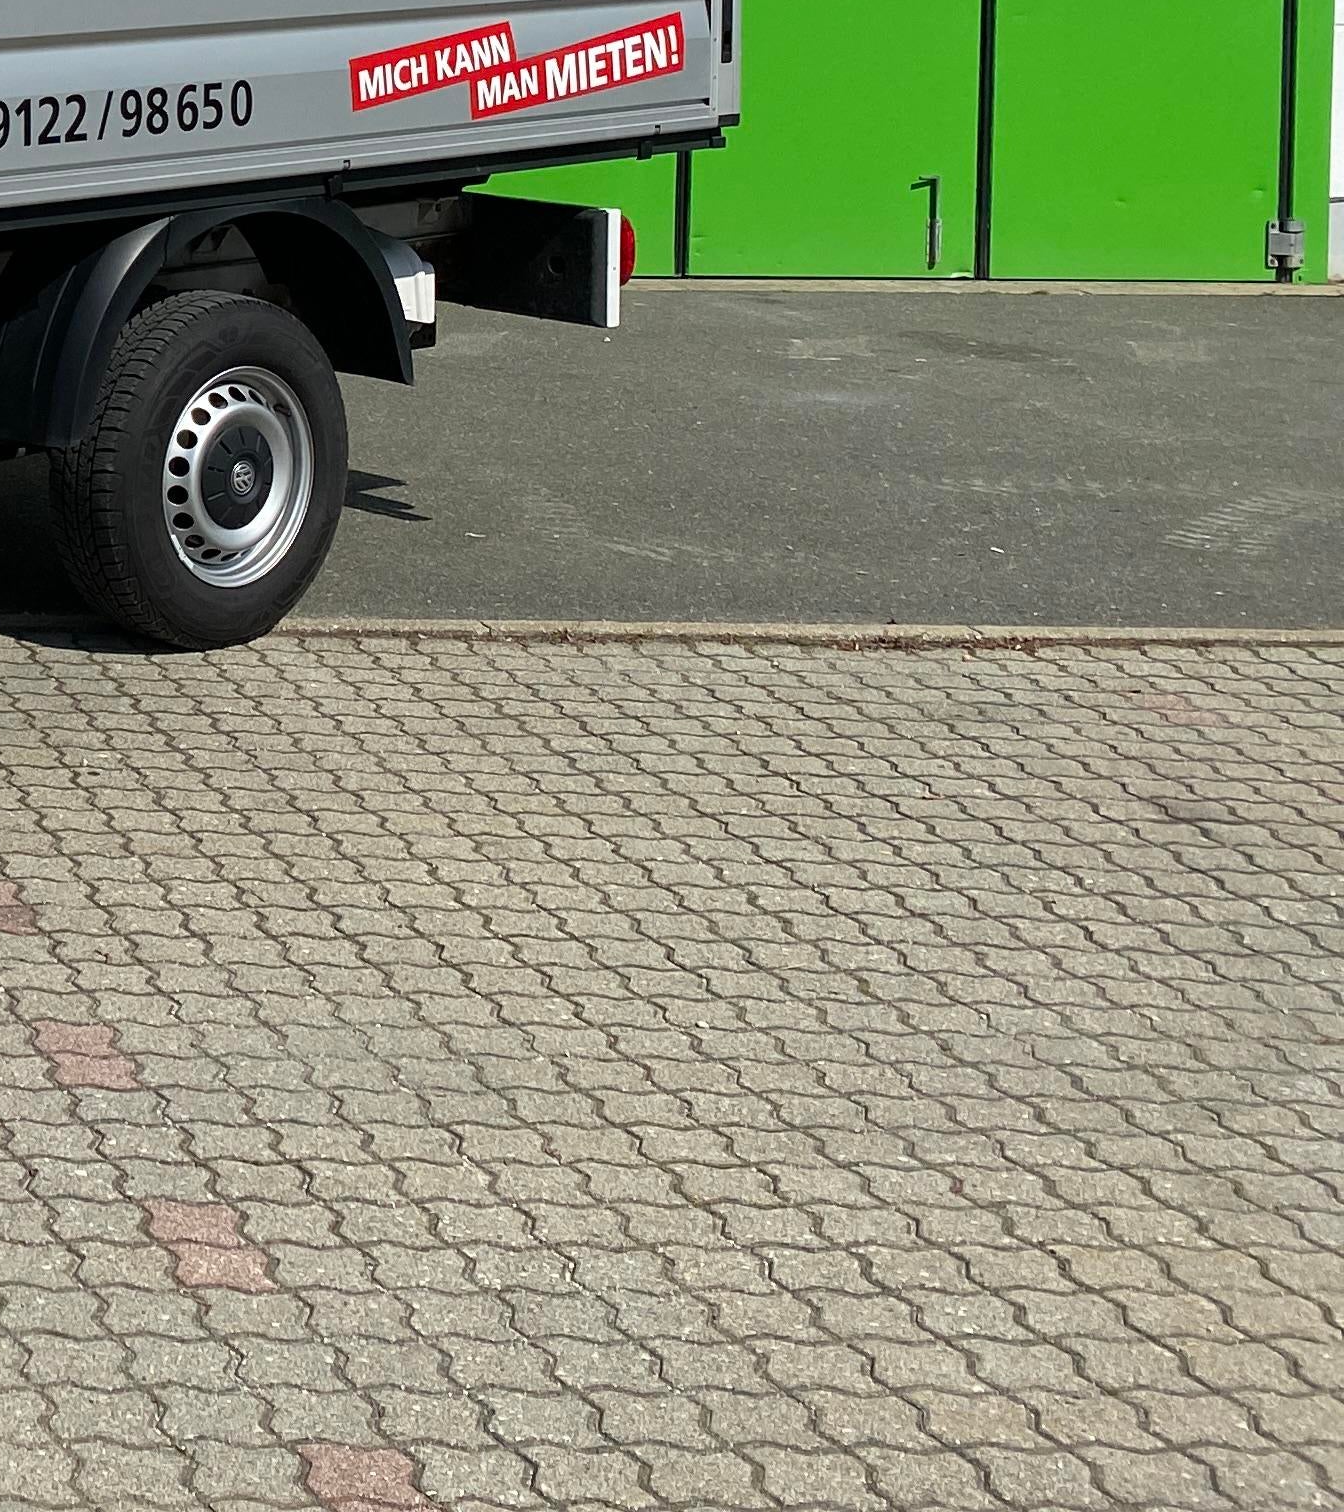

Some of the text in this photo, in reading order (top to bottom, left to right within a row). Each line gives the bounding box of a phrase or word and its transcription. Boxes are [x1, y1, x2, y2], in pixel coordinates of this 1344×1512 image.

[358, 32, 510, 101] MICH KANN
[477, 25, 680, 110] MAN MIETEN!
